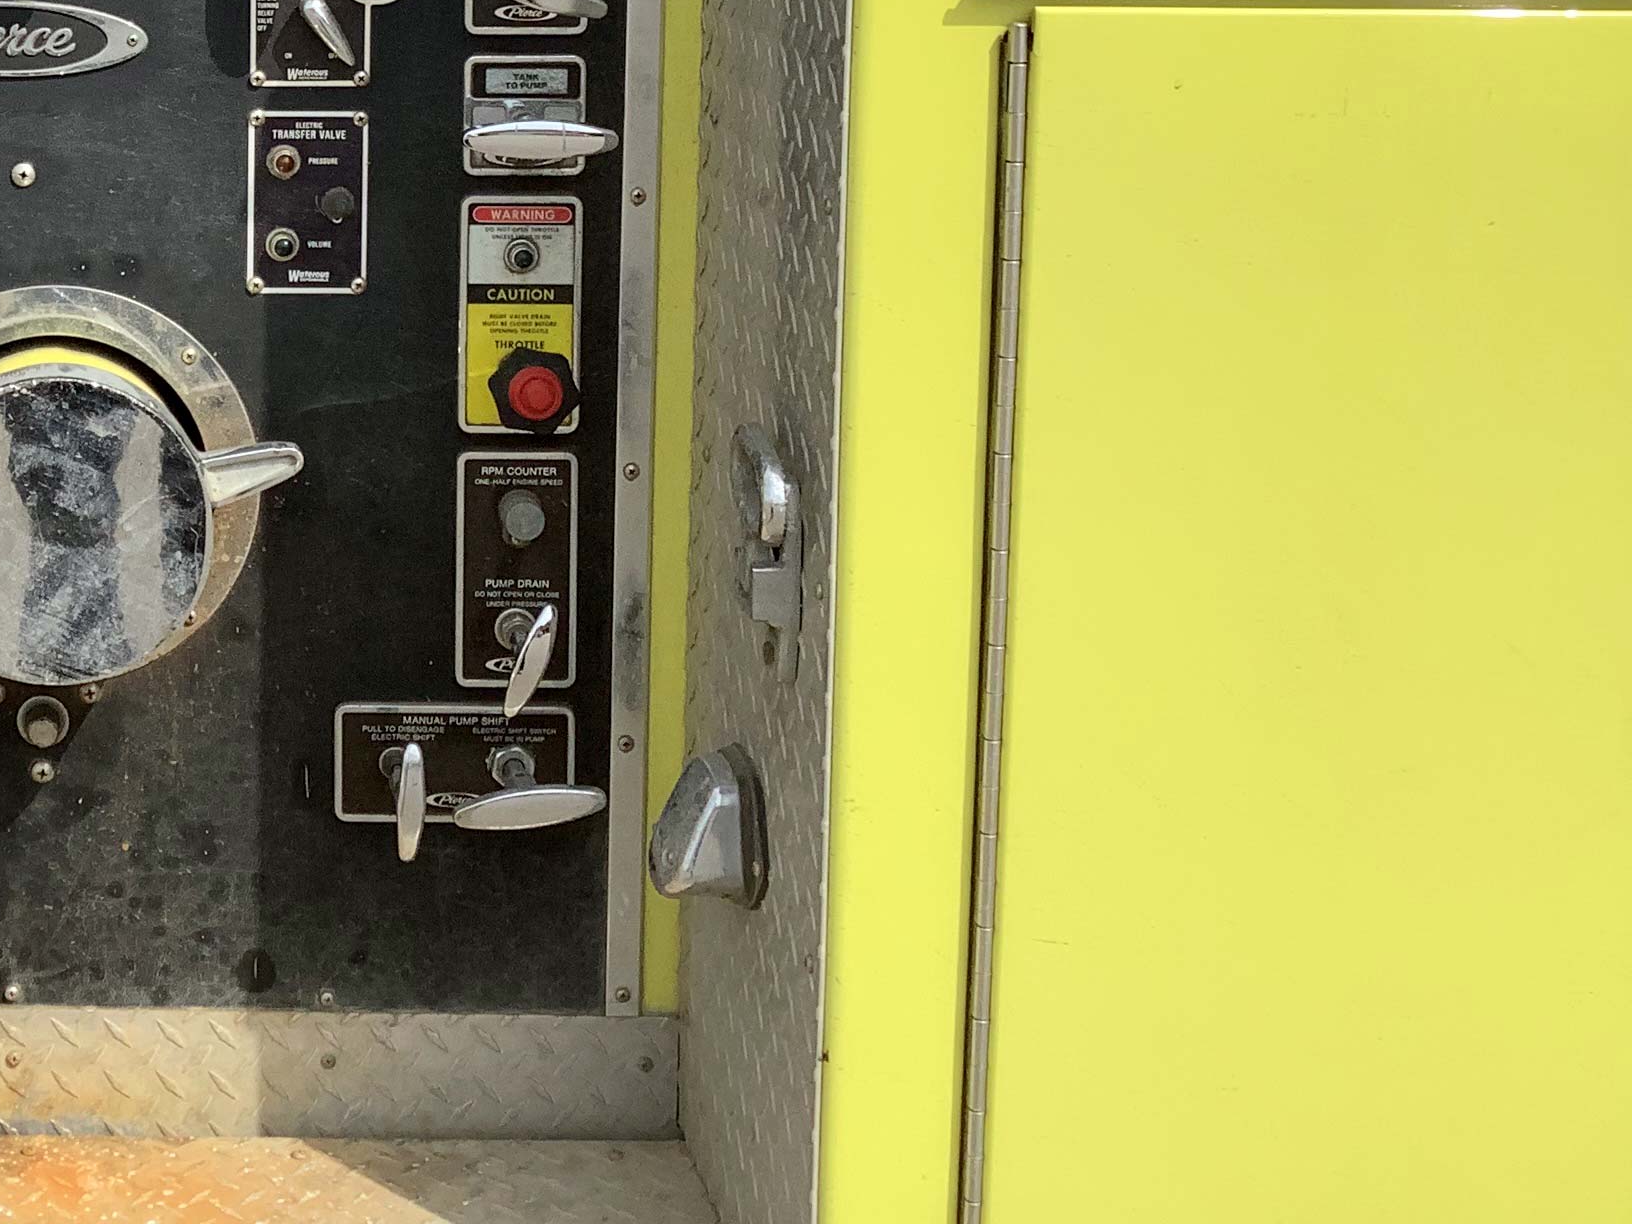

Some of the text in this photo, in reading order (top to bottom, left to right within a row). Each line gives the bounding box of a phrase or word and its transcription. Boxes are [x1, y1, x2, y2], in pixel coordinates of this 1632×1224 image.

[286, 68, 329, 80] Waterous
[513, 73, 539, 81] TANK
[272, 129, 347, 140] TRANSFER VALVE
[308, 157, 338, 165] PRESSURE
[490, 209, 556, 221] WARNING
[487, 288, 555, 302] CAUTION
[495, 340, 545, 350] THROTTLE
[481, 467, 557, 476] RPM COUNTER
[485, 579, 550, 589] PUMP DRAIN
[536, 591, 560, 599] CLOSE
[402, 716, 510, 726] MANUAL PUMP SHIFT
[362, 725, 445, 734] PULL TO DISENGAGE
[371, 733, 410, 741] ELECTRIC
